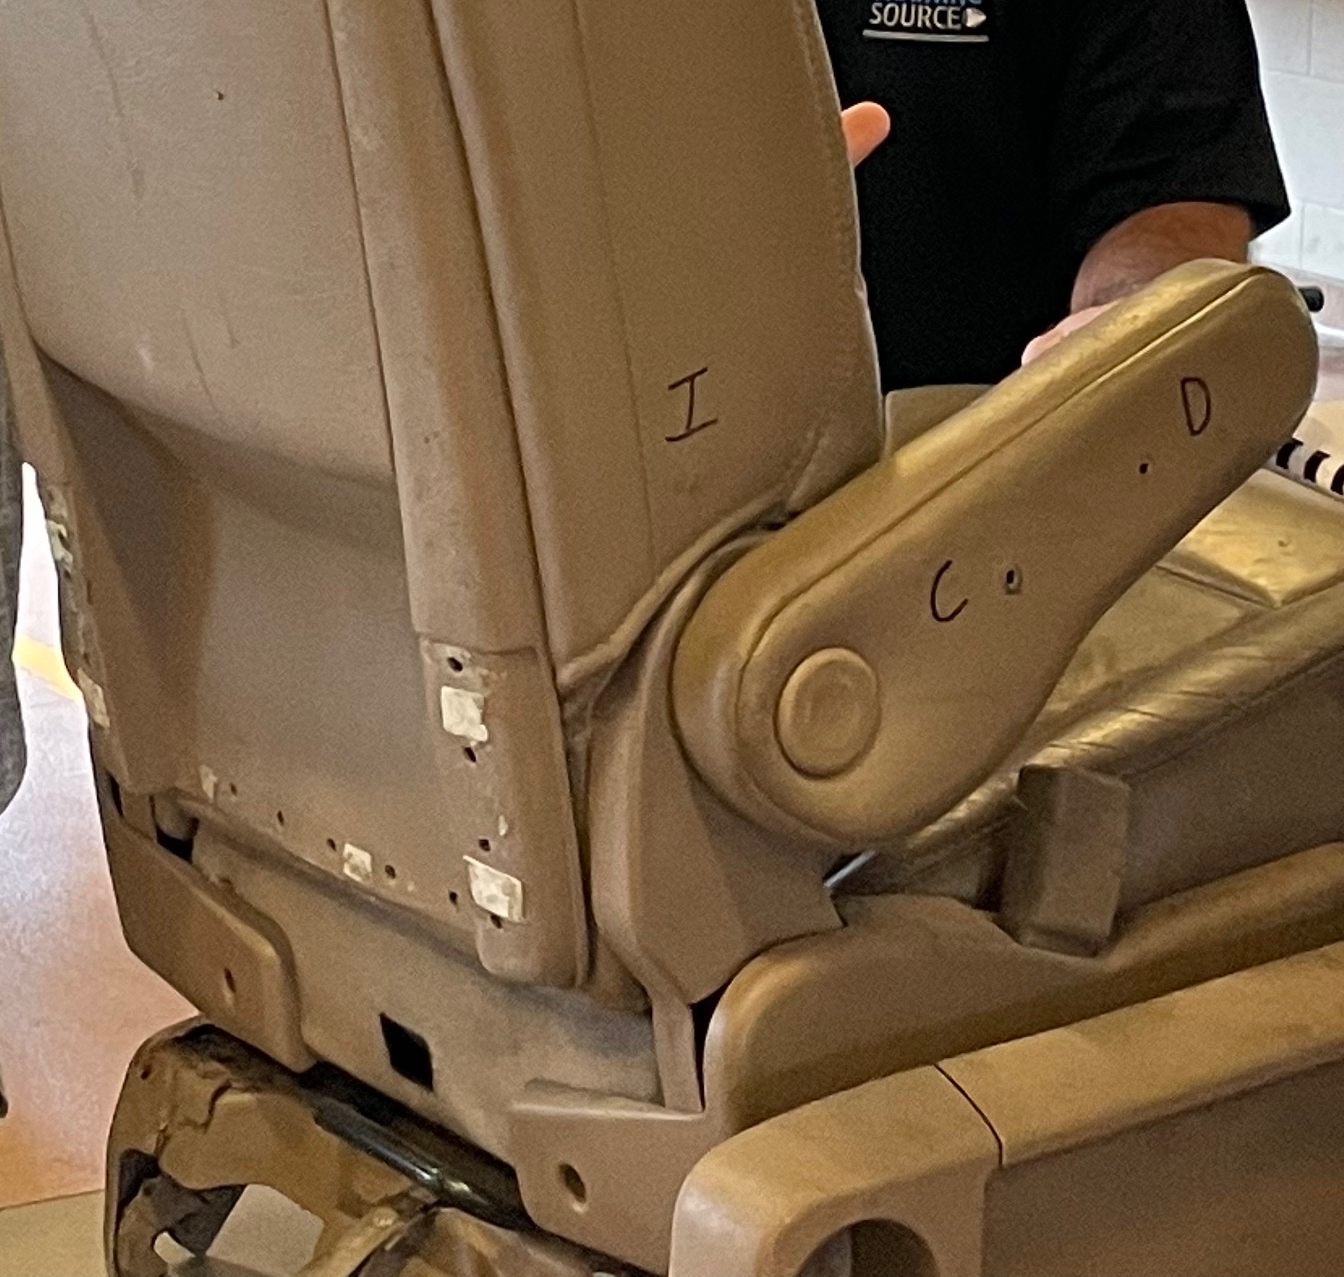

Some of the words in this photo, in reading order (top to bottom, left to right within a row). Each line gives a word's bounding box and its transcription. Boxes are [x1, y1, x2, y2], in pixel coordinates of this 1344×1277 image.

[869, 2, 961, 30] SOURCE
[665, 366, 719, 442] I
[1181, 377, 1212, 436] D
[930, 560, 968, 622] C
